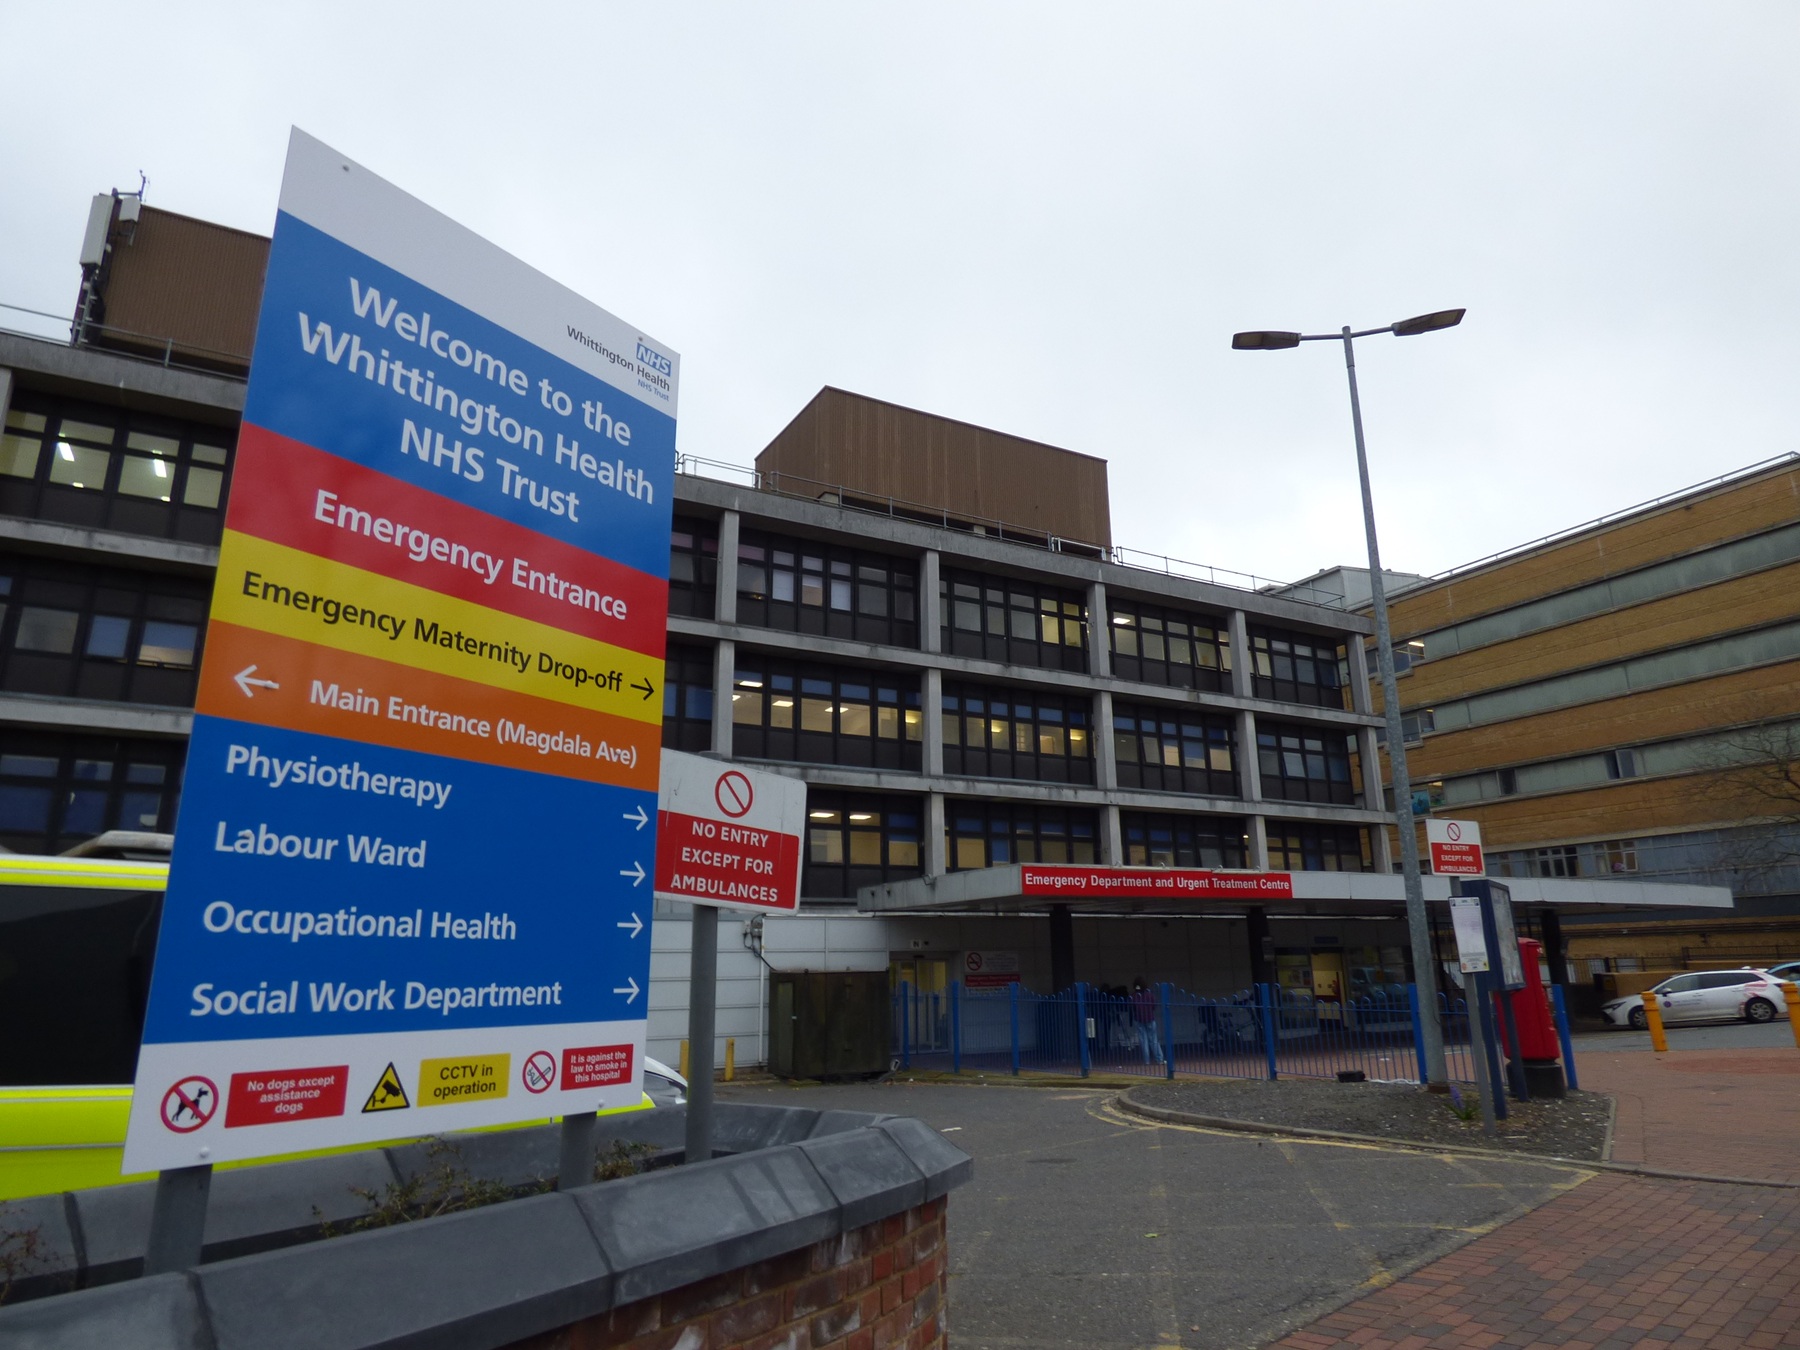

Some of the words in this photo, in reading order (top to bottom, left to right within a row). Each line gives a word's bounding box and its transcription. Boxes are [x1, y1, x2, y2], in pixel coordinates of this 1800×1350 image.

[350, 276, 529, 396] Welcome
[538, 378, 573, 417] to
[581, 400, 631, 446] the
[567, 325, 634, 371] Whittington
[637, 365, 670, 391] Health
[637, 343, 671, 376] NHS
[638, 379, 652, 392] NHS
[654, 387, 669, 402] Trust
[298, 311, 544, 456] Whittington
[555, 433, 654, 505] Health
[400, 418, 485, 483] NHS
[496, 458, 579, 523] Trust
[314, 488, 504, 585] Emergency
[511, 557, 627, 620] Entrance
[242, 570, 406, 640] Emergency
[413, 617, 531, 674] Maternity
[538, 651, 623, 693] Drop-off
[310, 679, 380, 715] Main
[387, 696, 490, 738] Entrance
[497, 718, 591, 758] (Magdala
[596, 740, 637, 769] Ave)
[226, 744, 452, 810] Physiotherapy
[215, 820, 339, 860] Labour
[347, 833, 427, 868] Ward
[692, 820, 716, 839] NO
[720, 826, 769, 847] ENTRY
[681, 846, 740, 870] EXCEPT
[744, 857, 773, 875] FOR
[670, 873, 778, 902] AMBULANCES
[1025, 873, 1087, 889] Emergency
[1090, 874, 1152, 889] Department
[1155, 876, 1174, 889] and
[1177, 876, 1209, 890] Urgent
[1212, 878, 1258, 890] Treatment
[1260, 879, 1290, 890] Centre
[203, 900, 423, 942] Occupational
[430, 911, 517, 940] Health
[190, 980, 299, 1016] Social
[308, 979, 395, 1013] Work
[404, 980, 562, 1016] Department
[440, 1065, 477, 1080] CCTV
[482, 1064, 493, 1077] in
[570, 1054, 577, 1064] It
[578, 1054, 585, 1063] is
[586, 1052, 613, 1064] against
[614, 1051, 626, 1060] the
[570, 1064, 584, 1073] law
[585, 1064, 593, 1072] to
[595, 1061, 619, 1070] smoke
[620, 1060, 627, 1068] in
[247, 1080, 264, 1092] No
[267, 1078, 296, 1091] dogs
[298, 1075, 335, 1088] except
[433, 1080, 496, 1100] operation
[575, 1072, 589, 1083] this
[591, 1070, 620, 1081] hospital
[260, 1089, 320, 1103] assistance
[274, 1102, 303, 1115] dogs
